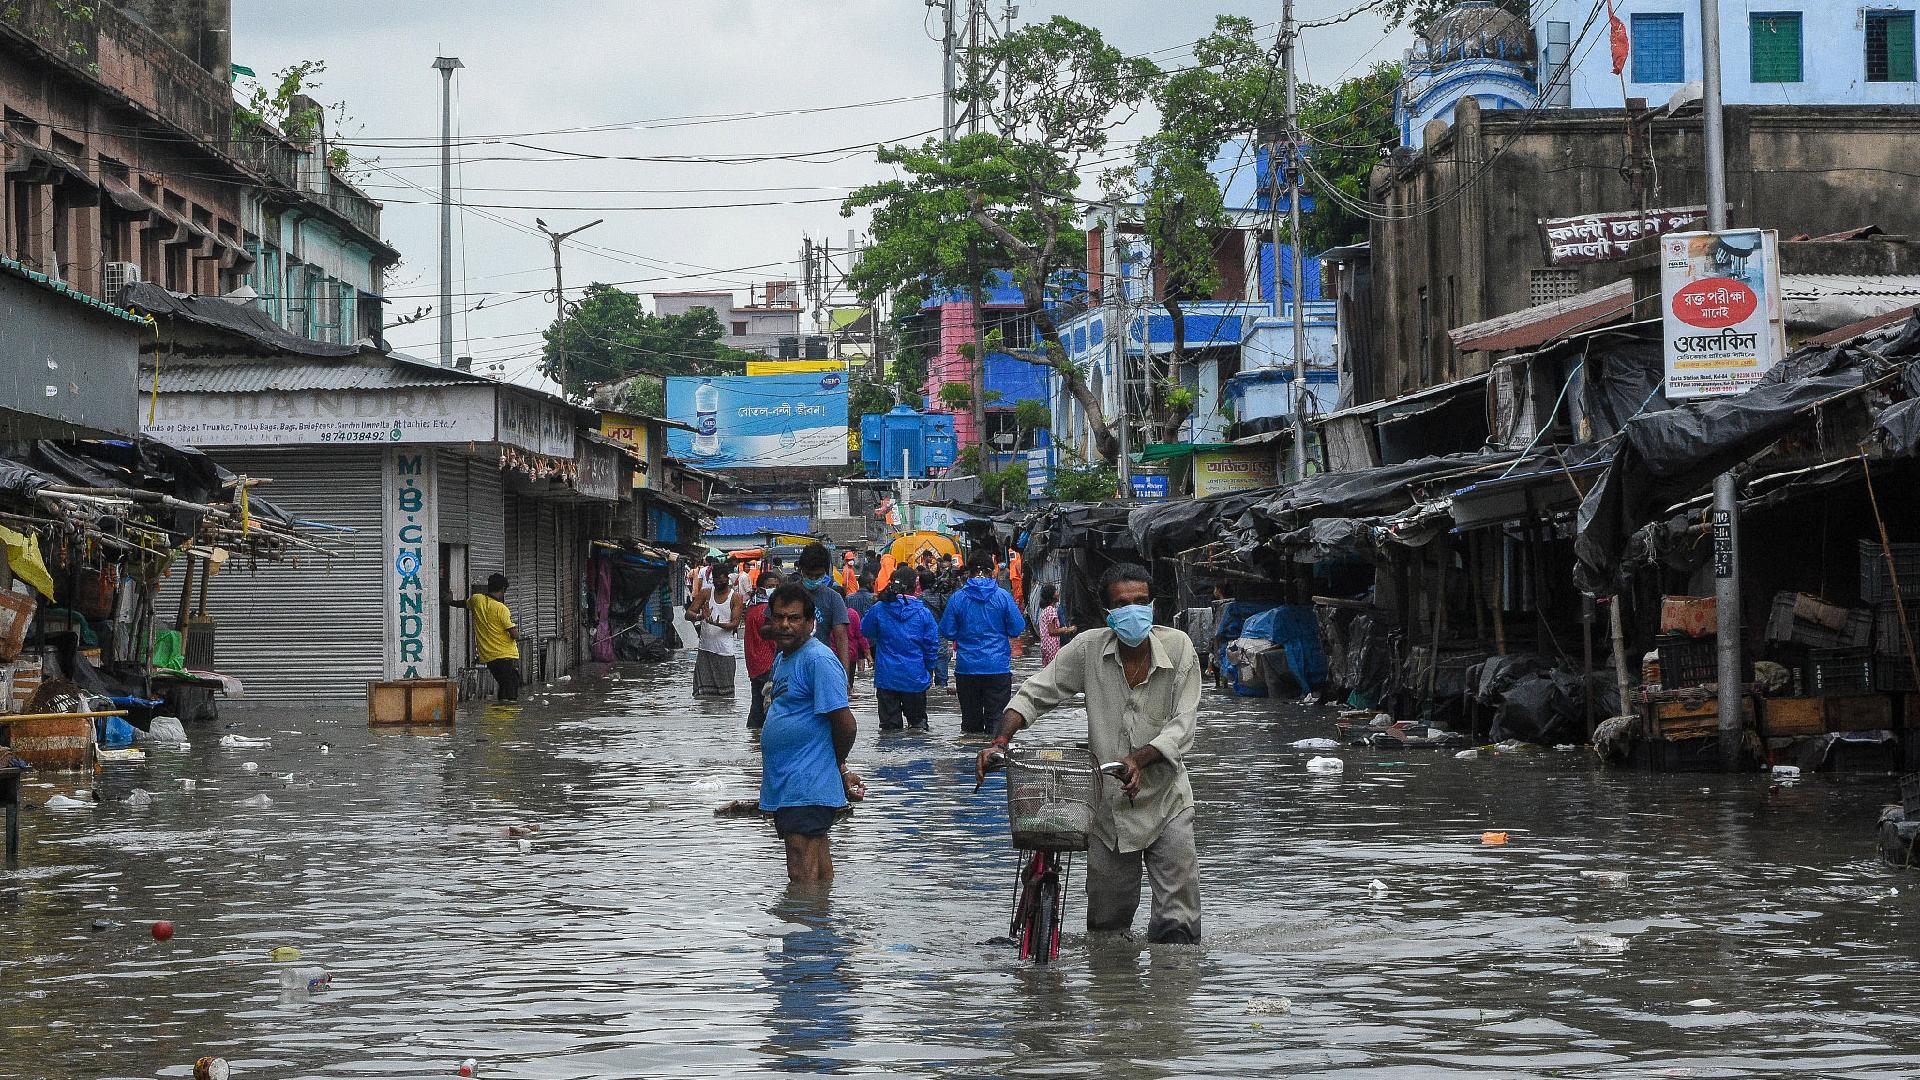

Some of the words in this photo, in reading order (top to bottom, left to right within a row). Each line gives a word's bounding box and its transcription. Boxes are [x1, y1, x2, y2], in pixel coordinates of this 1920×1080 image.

[1683, 292, 1705, 306] রক্ত
[1707, 287, 1746, 305] পরীক্ষা
[1701, 305, 1730, 319] মানেই
[1673, 327, 1758, 353] ওয়েলকিন
[178, 423, 200, 432] Steel
[321, 431, 385, 442] 9874038492
